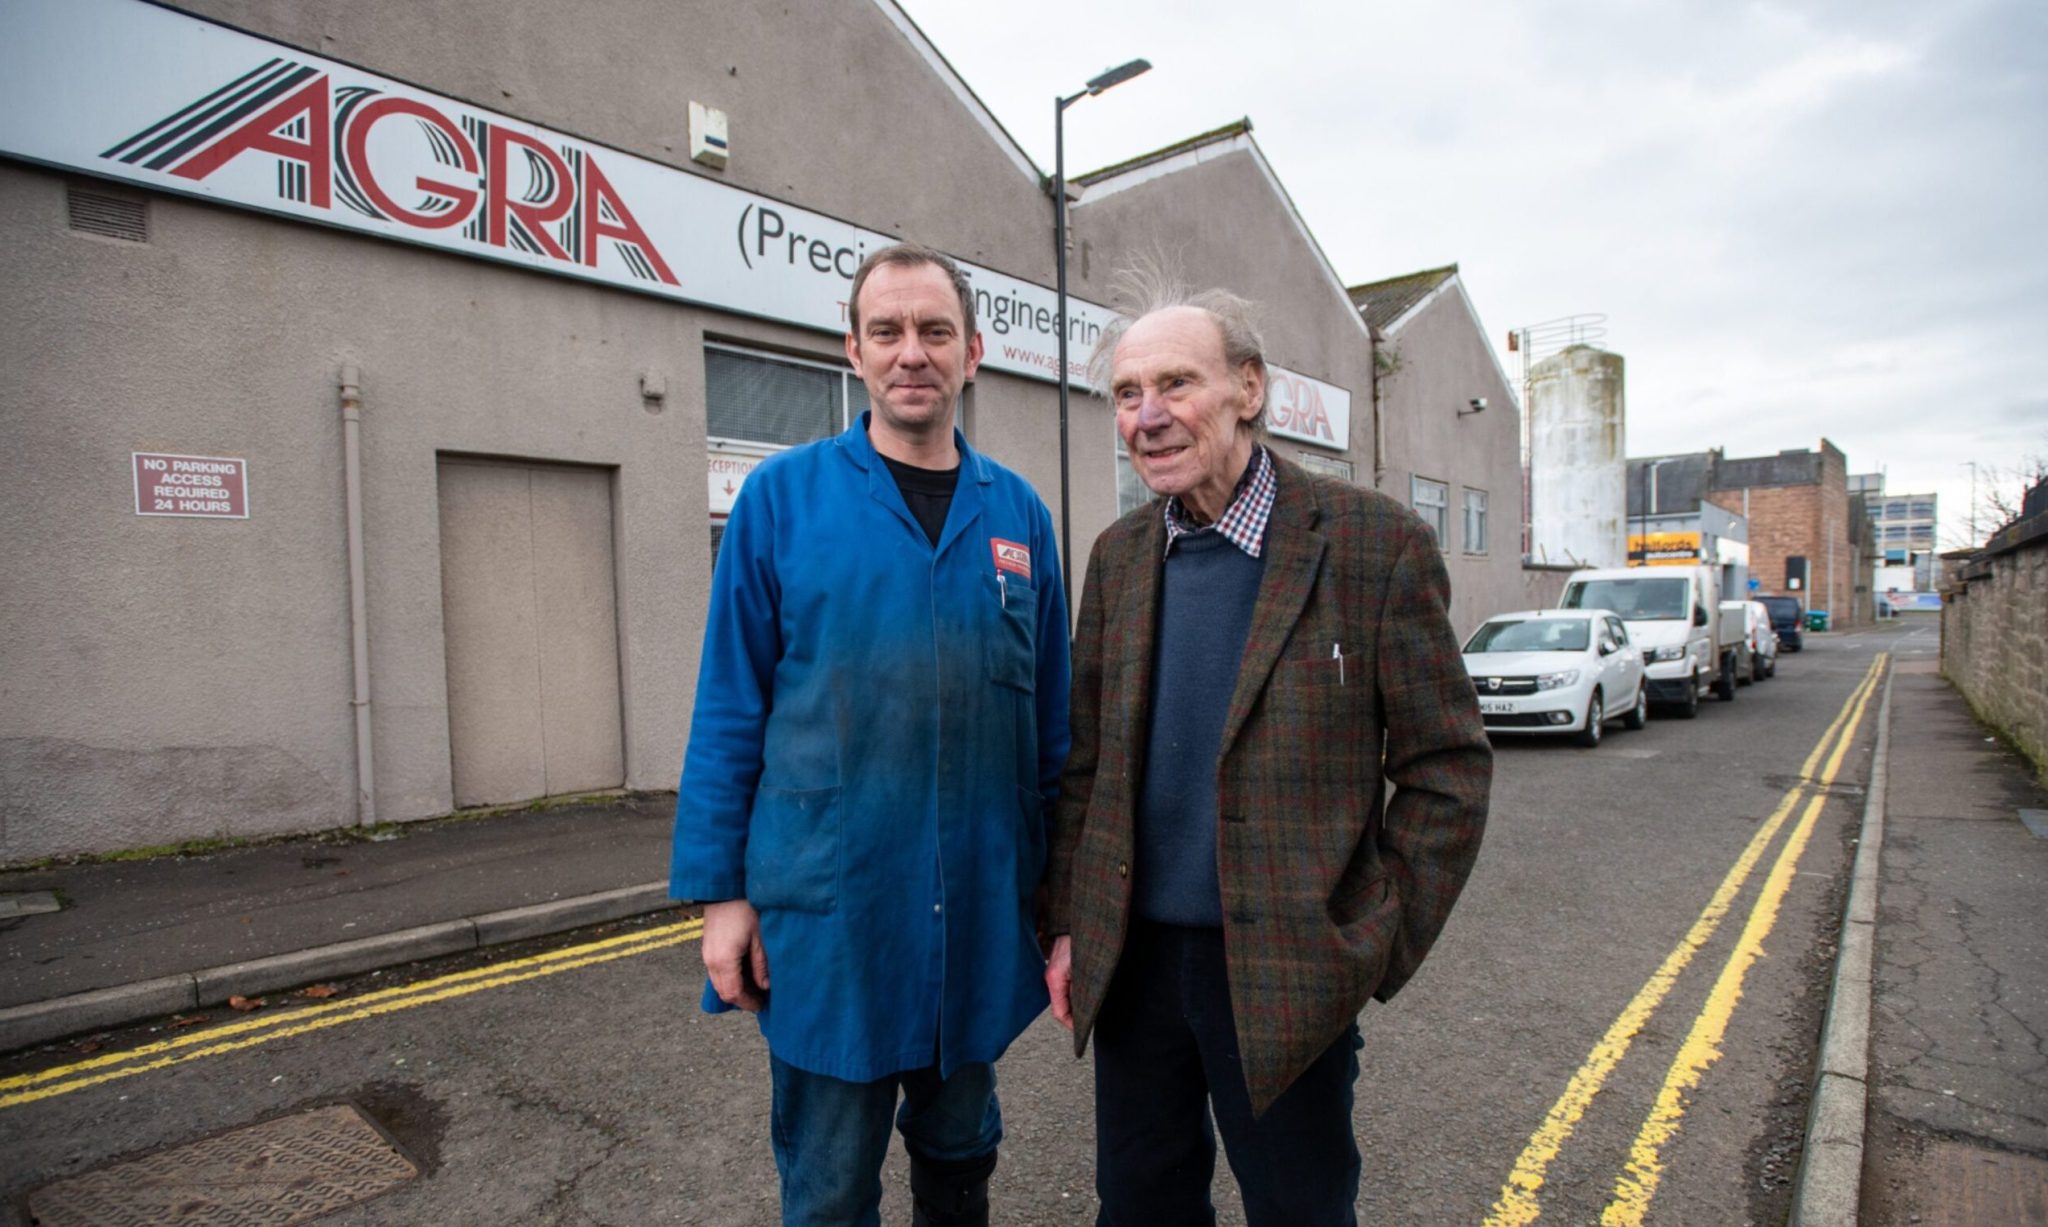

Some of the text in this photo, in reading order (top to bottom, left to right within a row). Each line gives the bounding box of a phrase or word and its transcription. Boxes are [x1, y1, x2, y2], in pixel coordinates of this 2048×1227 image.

[98, 57, 683, 287] AGRA
[738, 203, 1101, 346] (Preci ngineerin
[1266, 372, 1335, 442] GRA
[143, 459, 236, 475] NO PARKING
[161, 473, 222, 487] ACCESS
[153, 485, 230, 500] REQUIRED
[154, 498, 232, 513] 24 HOURS
